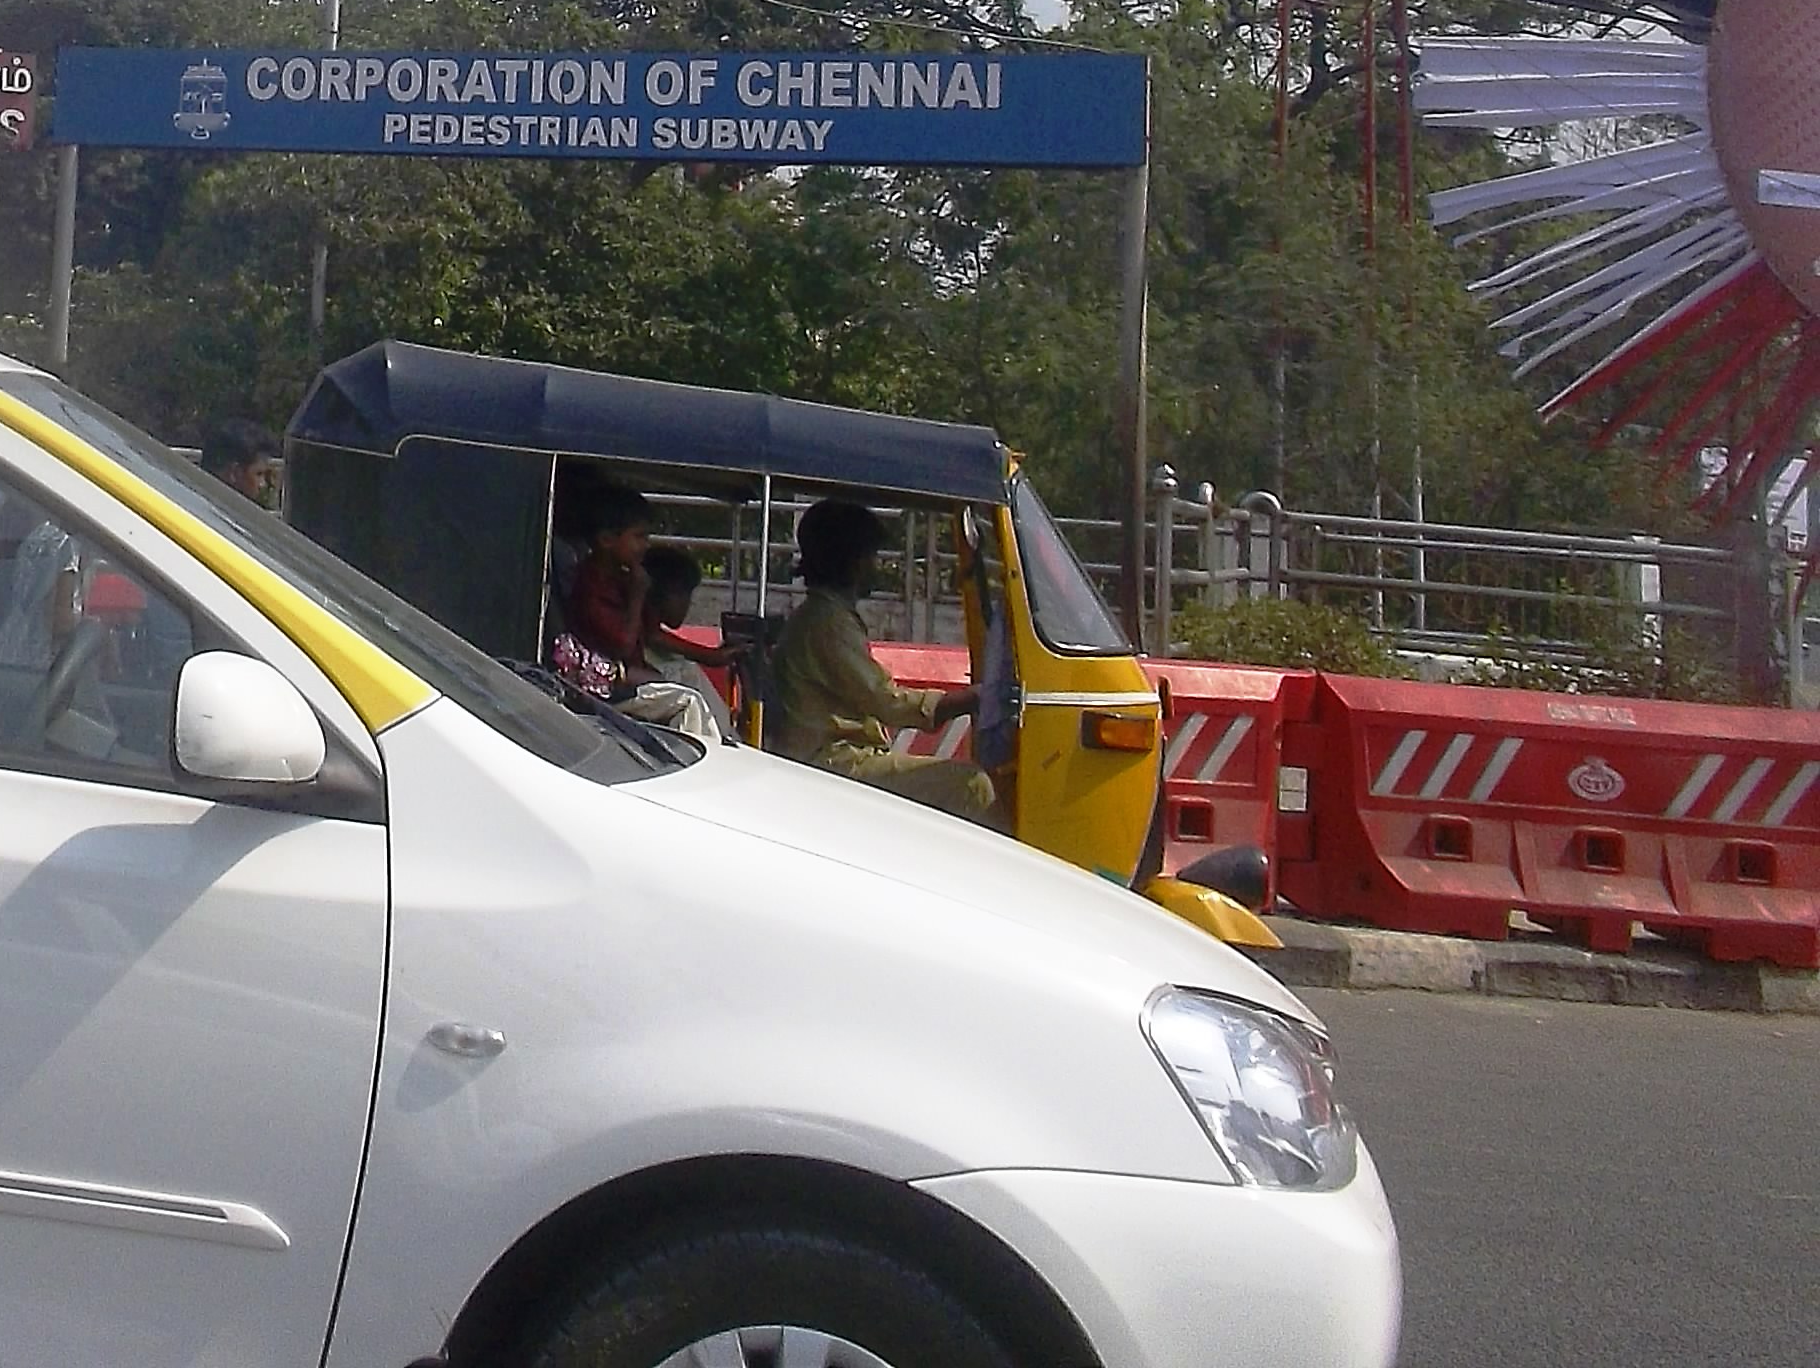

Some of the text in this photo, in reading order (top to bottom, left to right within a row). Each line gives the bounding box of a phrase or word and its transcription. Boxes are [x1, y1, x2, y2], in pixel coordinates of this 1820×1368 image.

[246, 56, 1001, 109] CORPORATION OF CHENNAI
[383, 113, 834, 151] PEDESTRIAN SUBWAY
